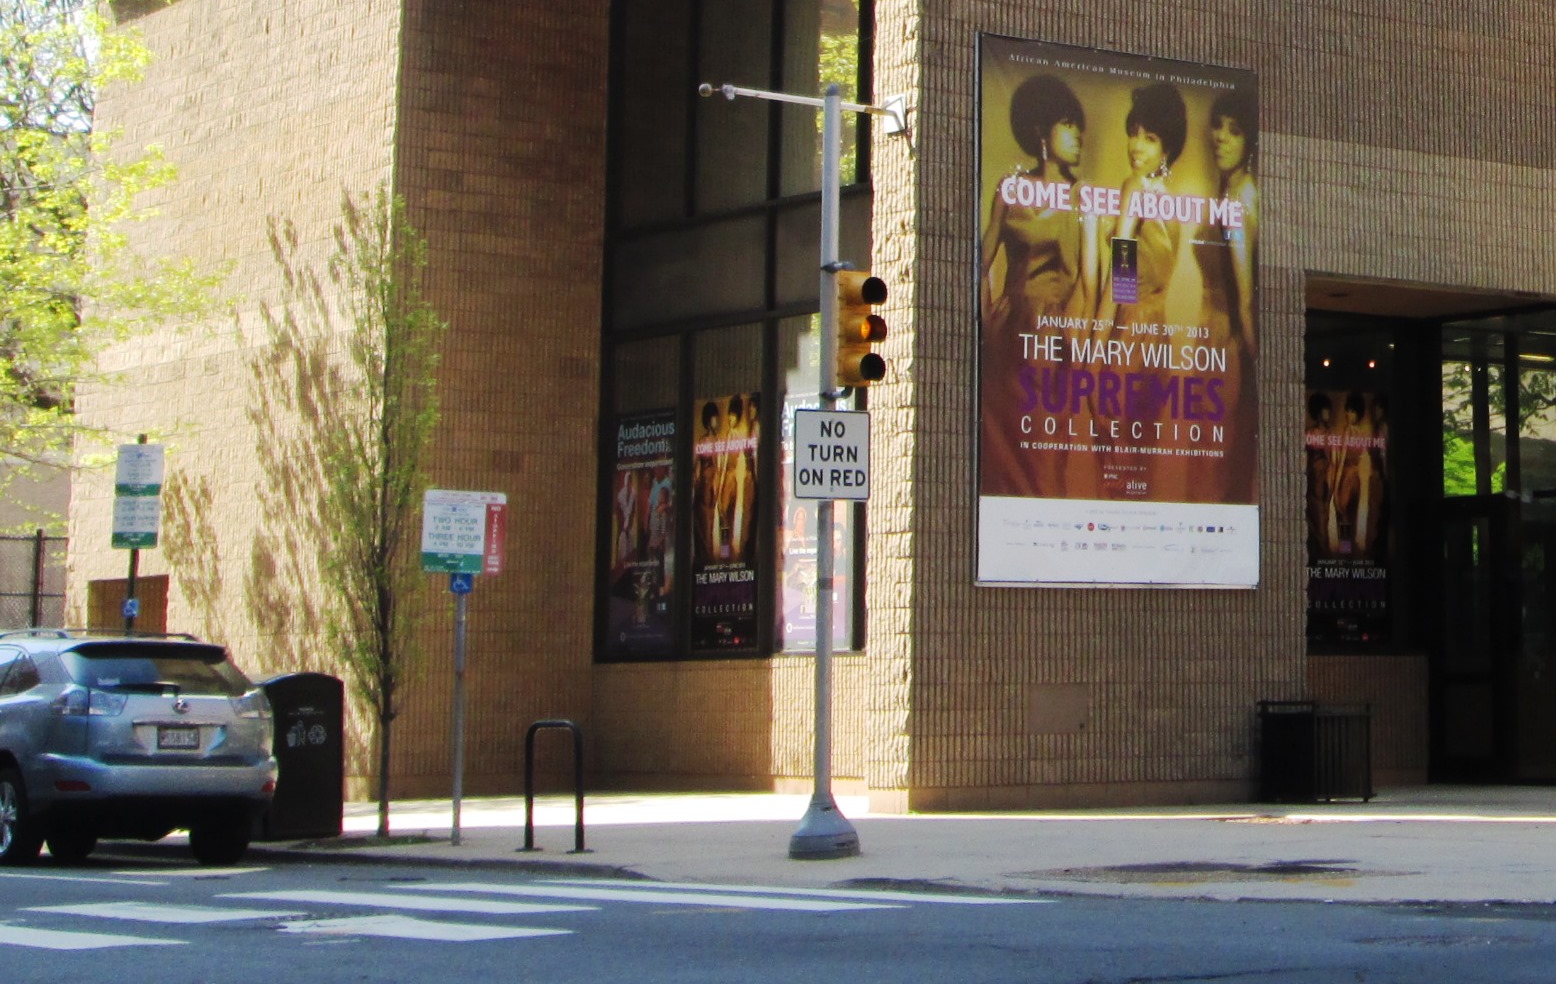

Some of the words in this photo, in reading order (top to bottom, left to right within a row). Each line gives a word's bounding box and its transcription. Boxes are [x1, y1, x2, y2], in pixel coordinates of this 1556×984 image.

[1008, 53, 1049, 66] African
[1054, 59, 1104, 73] American
[1109, 67, 1150, 79] Museum
[1155, 73, 1165, 81] in
[1170, 75, 1236, 90] Philadelphia
[1001, 176, 1072, 211] COME
[1078, 185, 1121, 216] SEE
[1128, 190, 1205, 224] ABOUT
[1209, 199, 1243, 228] ME
[1037, 315, 1089, 330] JANUARY
[1131, 322, 1159, 336] JUNE
[1186, 326, 1210, 339] 2013
[1018, 333, 1063, 362] THE
[1071, 337, 1135, 368] MARY
[1140, 342, 1226, 372] WILSON
[1018, 368, 1227, 423] SUPREMES
[617, 421, 675, 440] Audacious
[820, 420, 845, 438] NO
[1020, 415, 1224, 443] COLLECTION
[617, 438, 665, 458] Freedom
[1306, 433, 1326, 446] OME
[808, 445, 858, 462] TURN
[1020, 441, 1029, 449] IN
[1031, 442, 1088, 452] COOPERATION
[1091, 445, 1112, 453] WITH
[1175, 449, 1224, 458] EXHIBITIONS
[799, 468, 823, 486] ON
[830, 469, 866, 486] RED
[1126, 480, 1148, 490] alive
[695, 573, 708, 584] THE
[709, 571, 728, 583] MARY
[729, 570, 755, 582] WILSON
[1325, 567, 1350, 579] MARY
[1352, 568, 1387, 580] WILSON
[695, 602, 754, 615] COLLECTION
